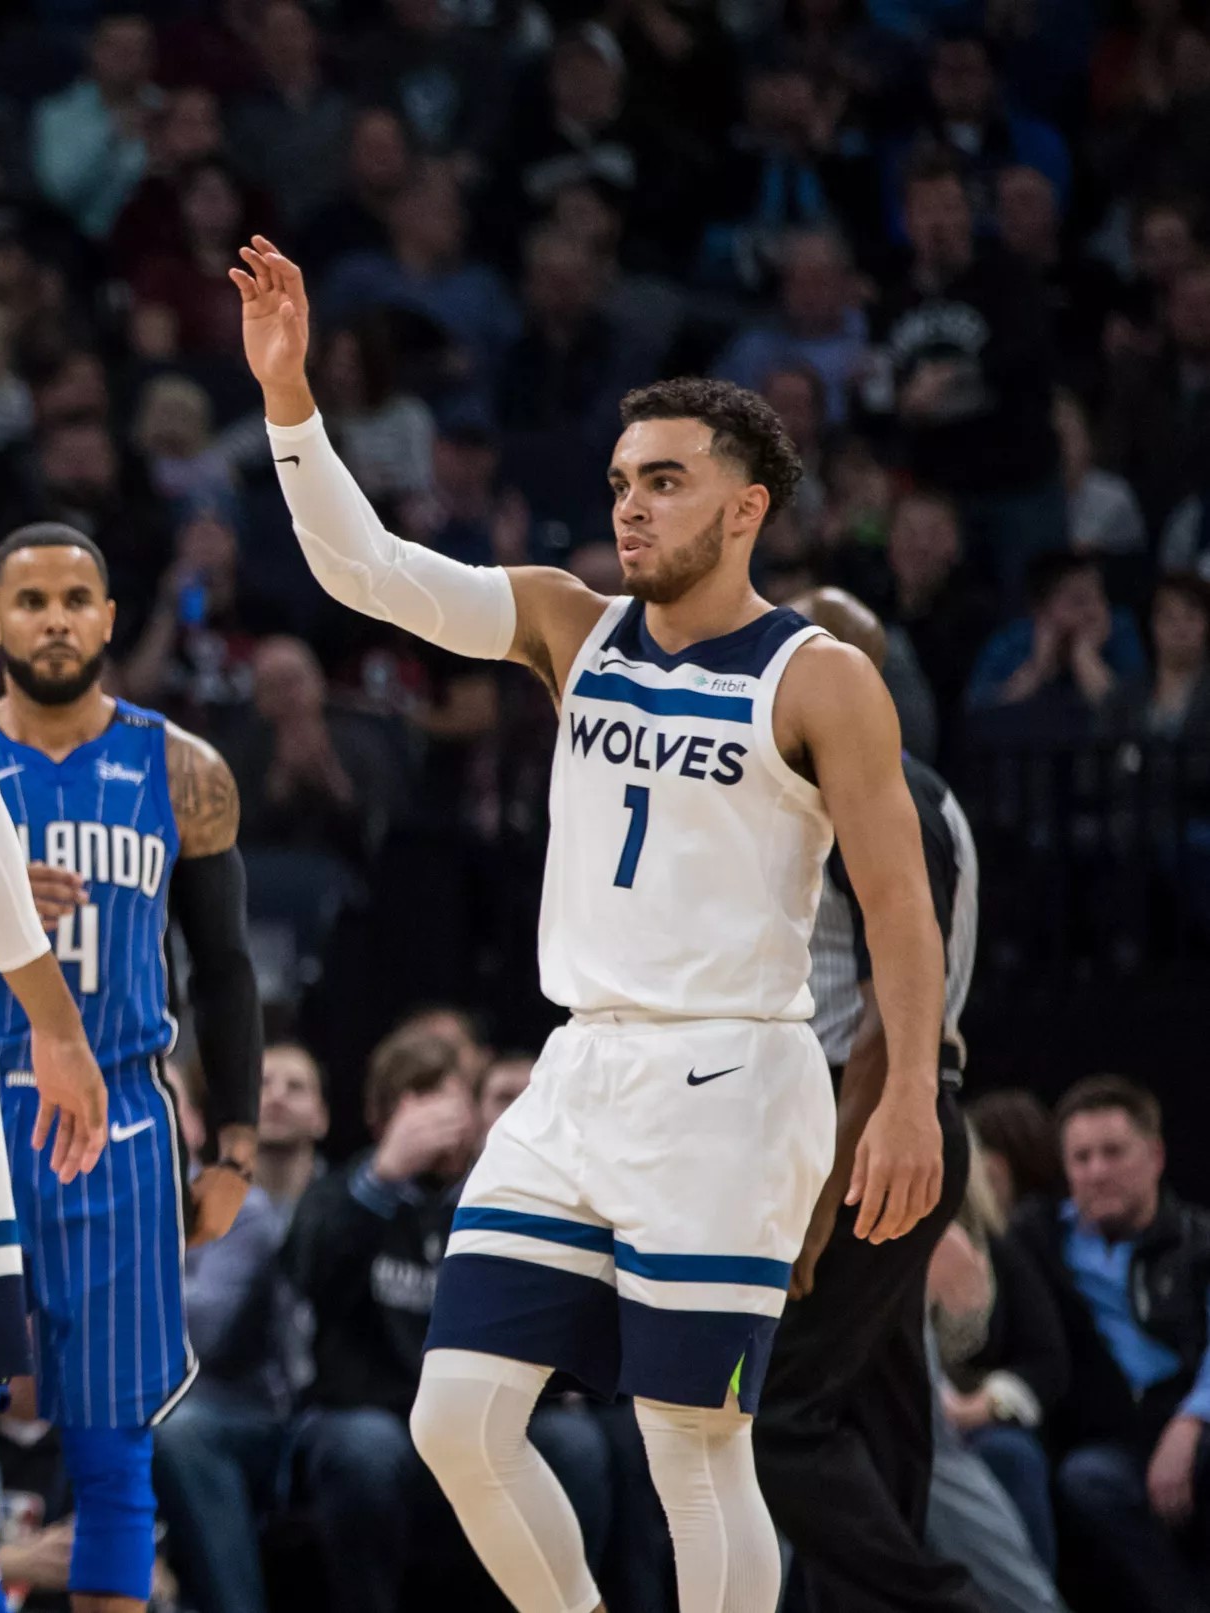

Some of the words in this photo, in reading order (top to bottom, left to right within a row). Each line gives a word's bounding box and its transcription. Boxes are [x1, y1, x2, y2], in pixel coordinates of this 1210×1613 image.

[710, 679, 747, 692] fitbit
[570, 712, 748, 785] WOLVES
[613, 784, 650, 889] 1
